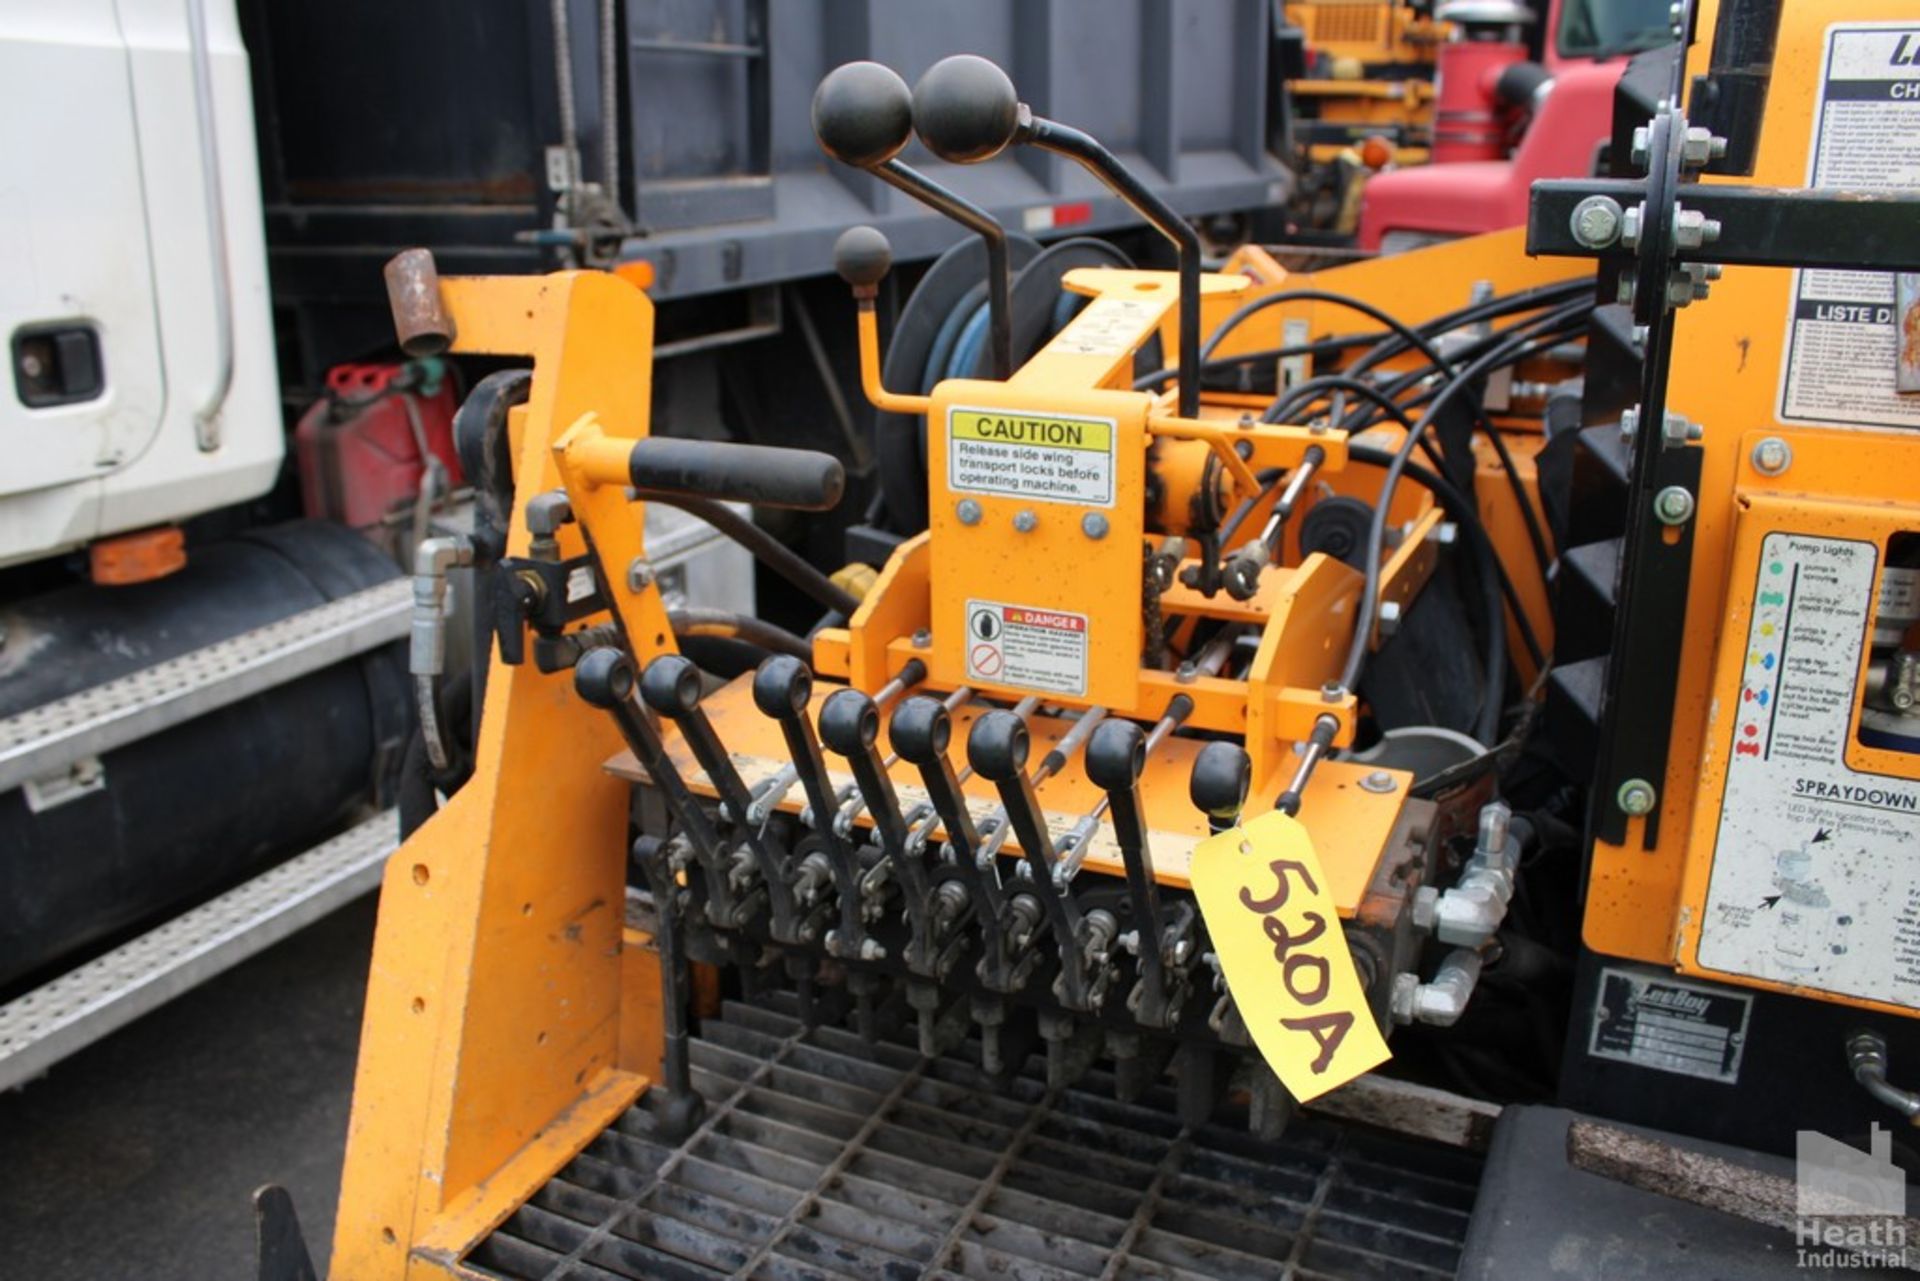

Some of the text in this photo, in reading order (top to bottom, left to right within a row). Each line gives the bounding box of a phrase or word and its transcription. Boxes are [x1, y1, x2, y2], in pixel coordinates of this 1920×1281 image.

[1816, 305, 1871, 322] LISTE
[976, 417, 1083, 445] CAUTION
[959, 443, 1073, 466] Release side wing
[959, 458, 1100, 481] transport locks before
[959, 471, 1081, 494] operating machine.
[1789, 541, 1854, 556] Pump Lights
[1024, 612, 1077, 629] DANGER
[1795, 778, 1917, 809] SPRAYDOWN
[1786, 813, 1804, 824] top
[1805, 815, 1816, 824] of
[1818, 817, 1835, 826] the
[1788, 803, 1806, 813] LED
[1808, 806, 1833, 818] lights
[1835, 810, 1875, 823] located
[1239, 860, 1355, 1075] 520A
[1635, 984, 1712, 1016] LeeBoy
